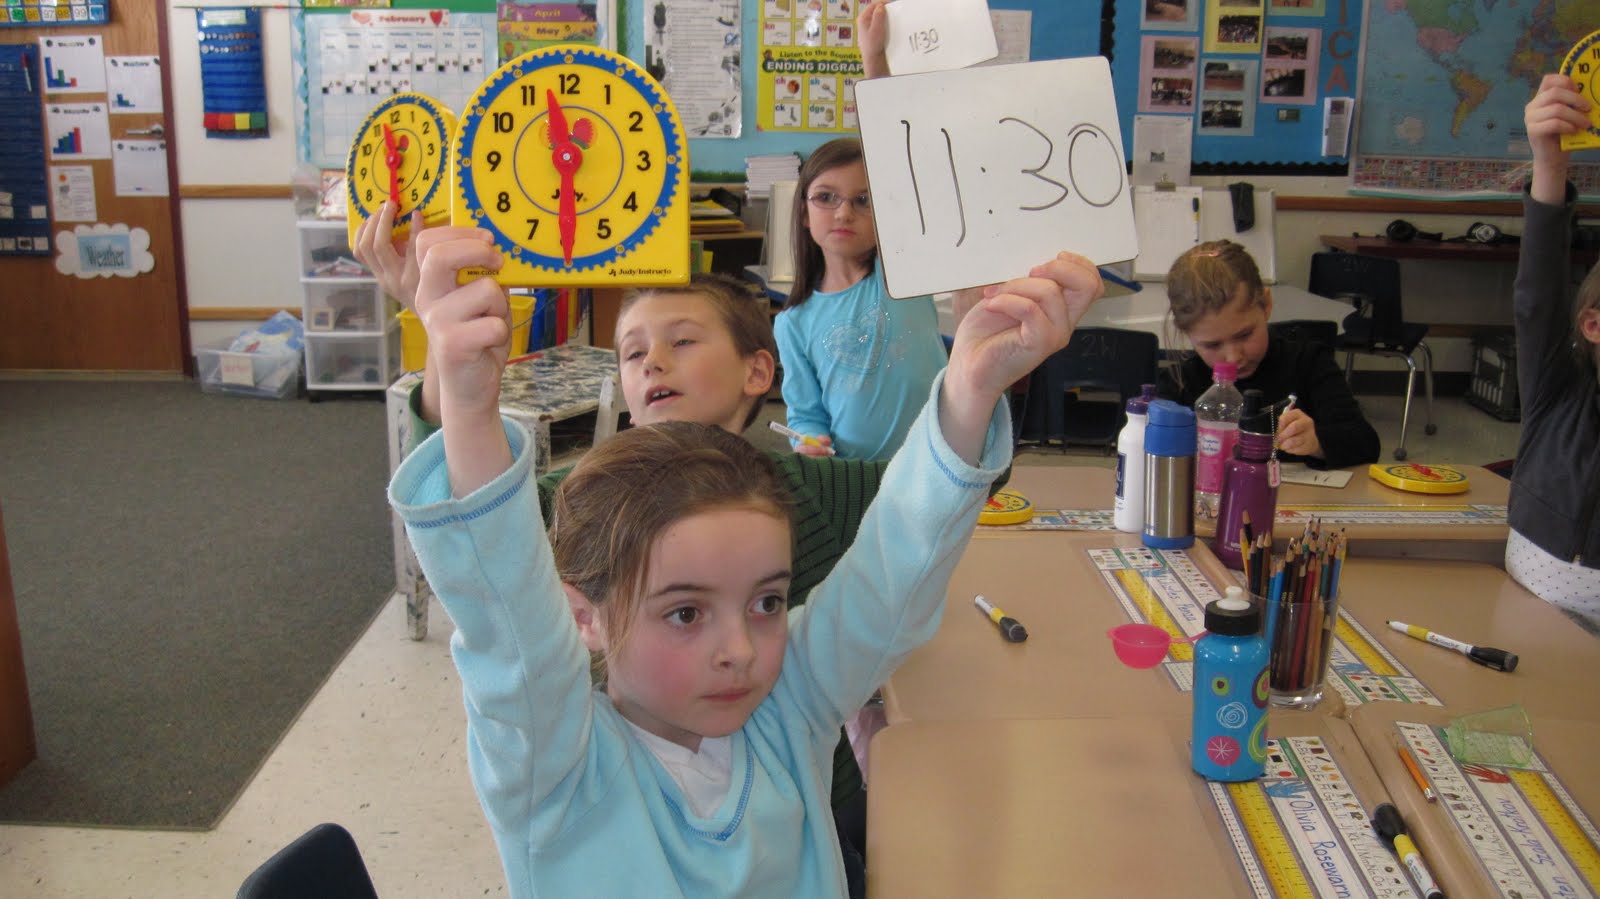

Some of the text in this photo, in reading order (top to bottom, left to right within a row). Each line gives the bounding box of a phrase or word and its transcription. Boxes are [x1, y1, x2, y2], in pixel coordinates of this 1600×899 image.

[379, 15, 426, 24] February
[535, 9, 561, 19] April
[536, 28, 560, 36] May
[909, 28, 939, 53] 11:30
[767, 61, 865, 72] ENDING DIGRAP
[1578, 63, 1590, 73] 10
[559, 74, 581, 95] 12
[521, 84, 611, 106] 11 1
[390, 110, 415, 124] 12 1
[491, 112, 514, 133] 10
[628, 111, 643, 132] 2
[422, 121, 430, 134] 2
[362, 143, 435, 157] 10 3
[486, 151, 502, 172] 9
[636, 150, 651, 171] 3
[360, 167, 430, 181] 9 4
[900, 117, 1123, 247] 11:30
[366, 188, 418, 202] 8 5
[496, 191, 638, 213] 8 4
[526, 218, 612, 240] 7 5
[1289, 800, 1350, 899] Olivia Rosewarn
